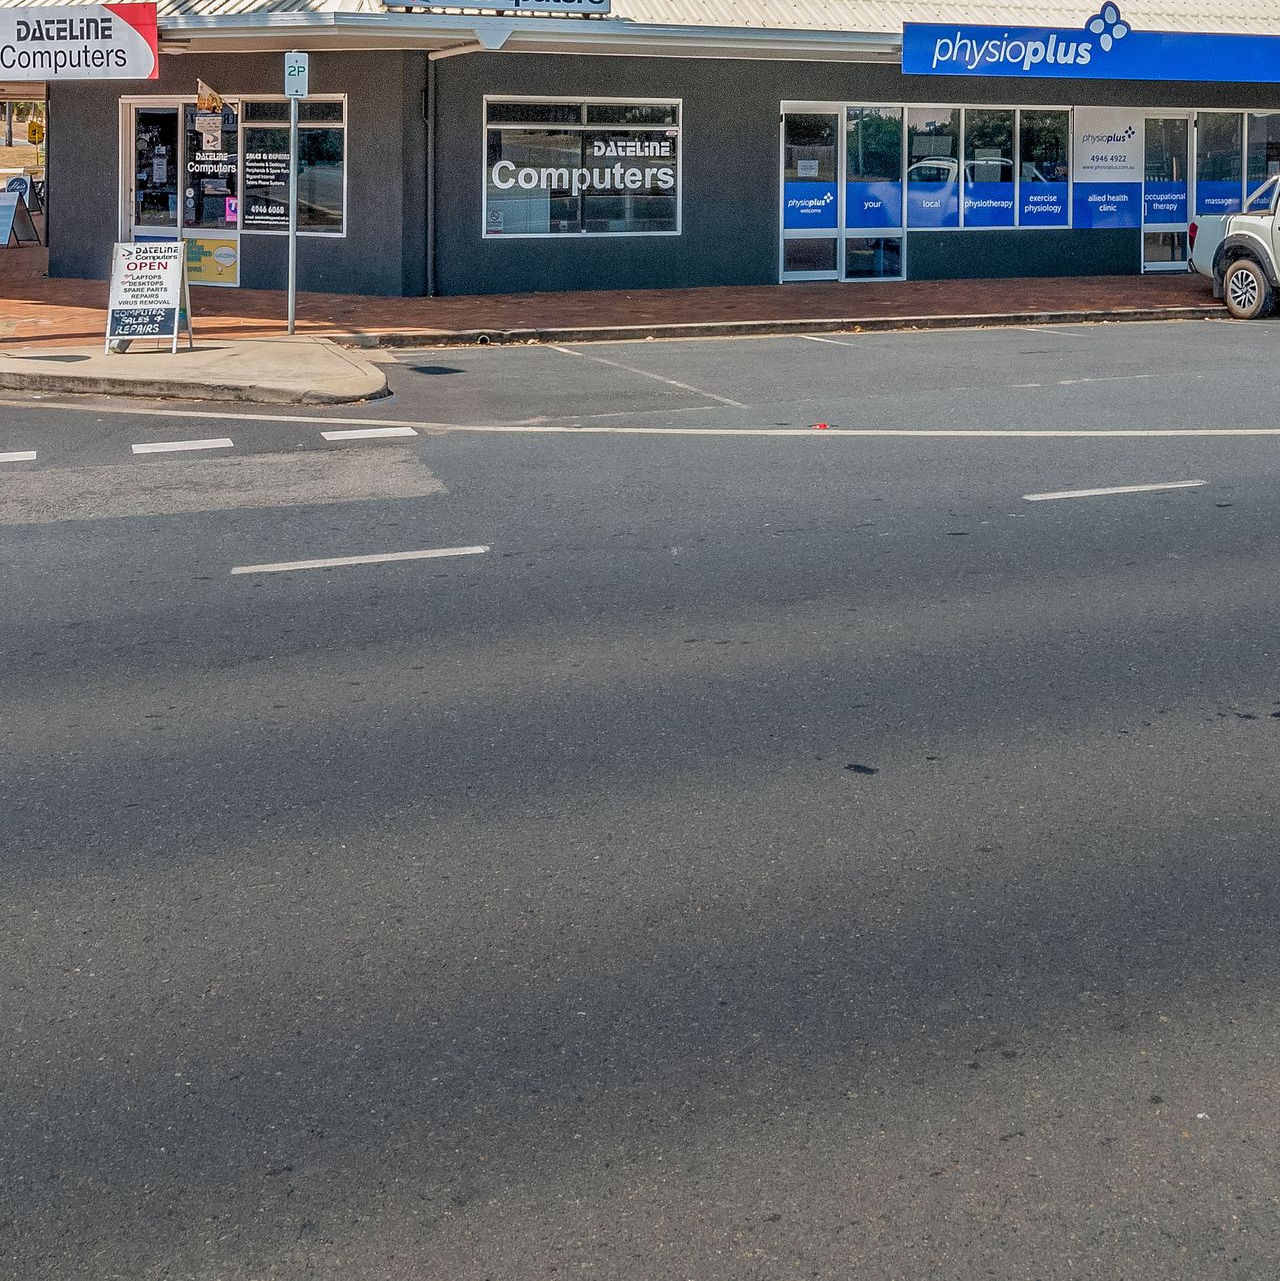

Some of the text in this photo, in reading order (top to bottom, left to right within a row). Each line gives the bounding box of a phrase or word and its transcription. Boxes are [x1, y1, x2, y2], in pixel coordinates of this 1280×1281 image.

[931, 31, 1093, 71] physioplus
[0, 44, 128, 74] Computers
[287, 65, 306, 77] 2P
[1090, 155, 1127, 163] 4946 4922
[187, 161, 237, 175] Computers
[491, 160, 675, 196] Computers
[1029, 194, 1058, 203] exercise
[1087, 194, 1129, 202] allied health
[1144, 193, 1186, 201] occupational
[863, 200, 882, 210] your
[922, 199, 941, 208] local
[964, 199, 1014, 209] physiotherapy
[1099, 203, 1118, 212] clinic
[1152, 202, 1178, 211] therapy
[1024, 204, 1062, 214] physiology
[126, 261, 168, 271] OPEN
[113, 308, 166, 318] COMPUTER
[120, 316, 150, 326] SALES
[115, 324, 160, 335] REPAIRS
